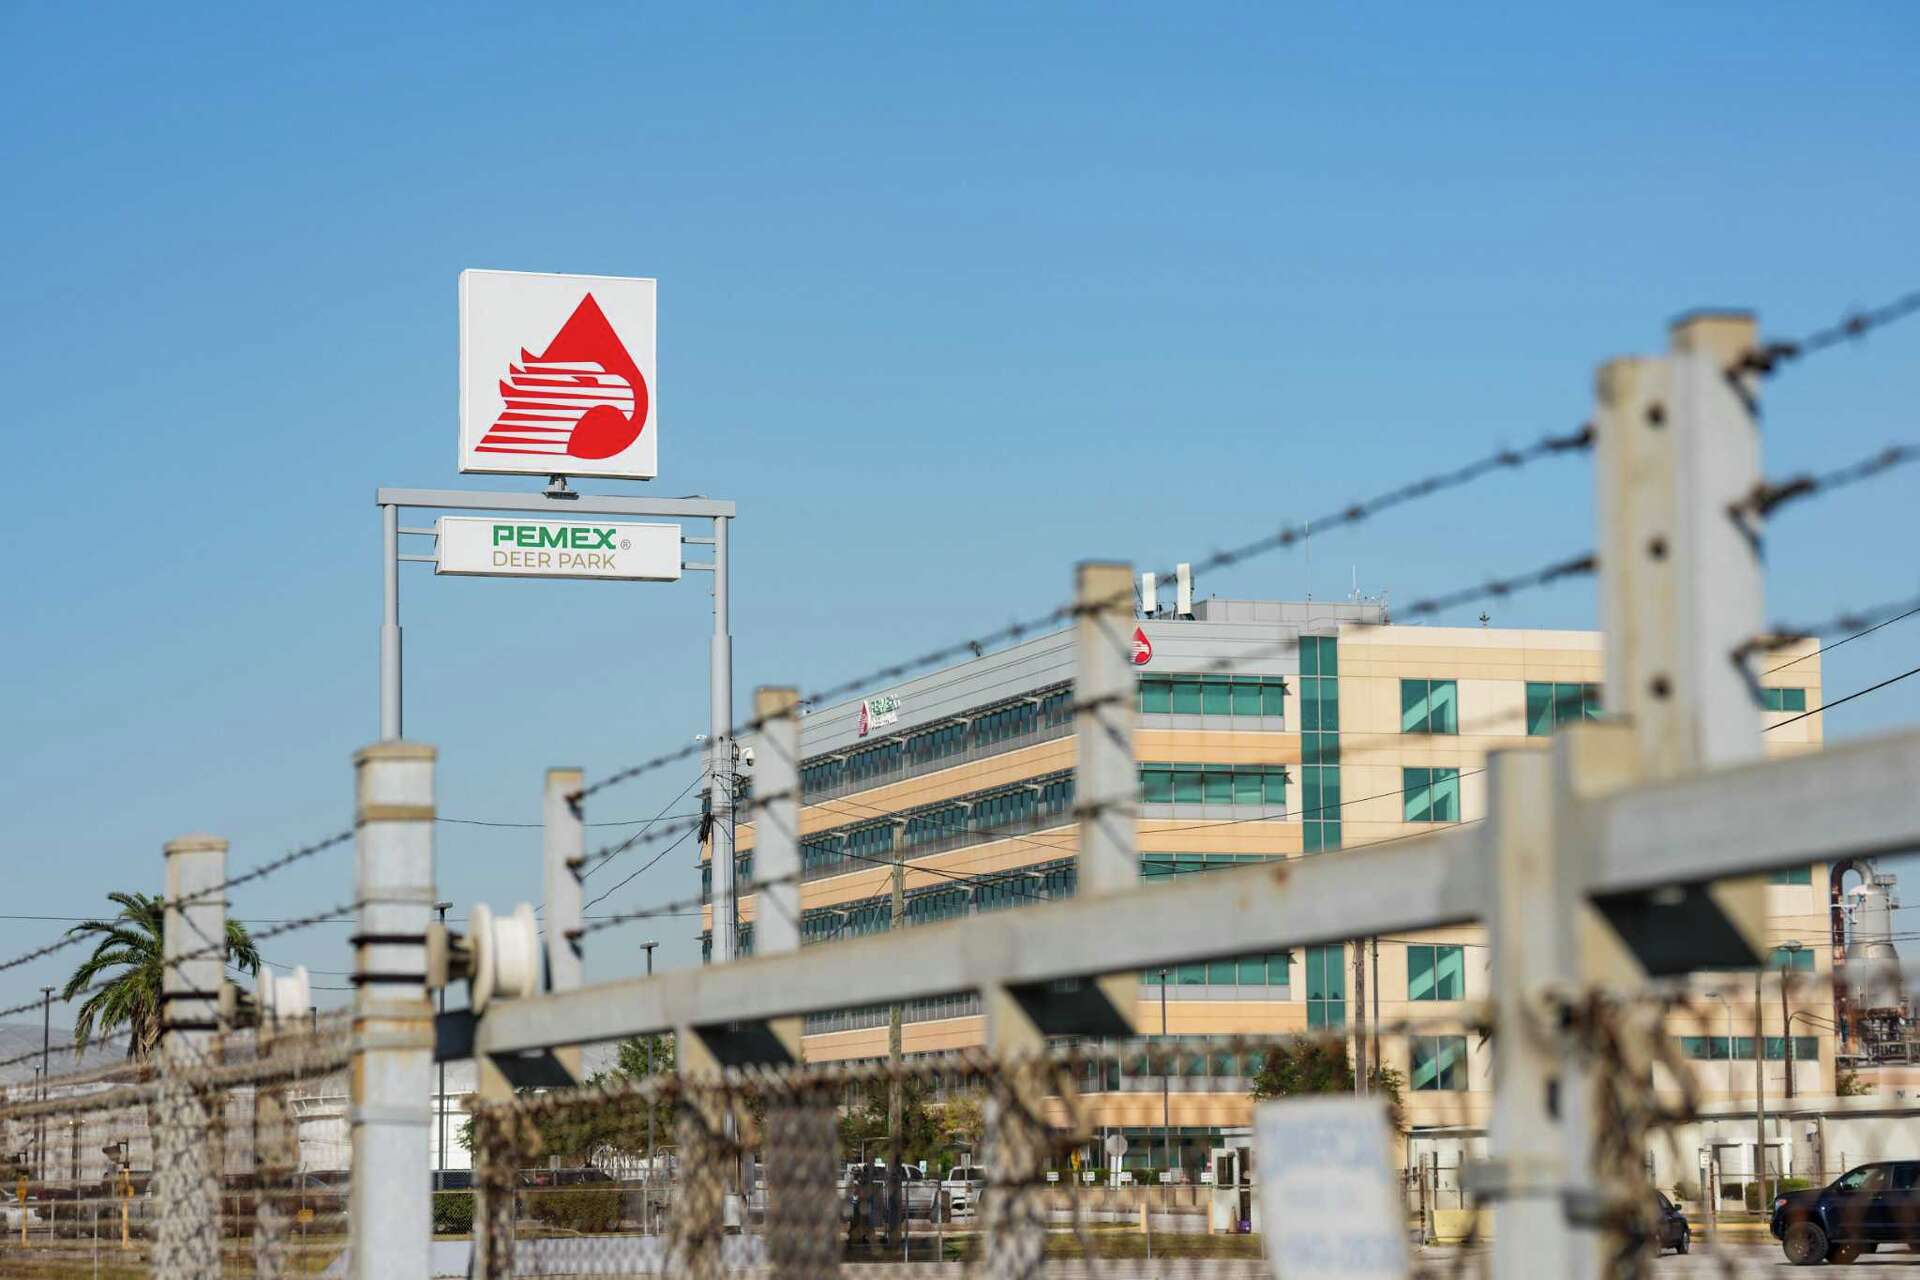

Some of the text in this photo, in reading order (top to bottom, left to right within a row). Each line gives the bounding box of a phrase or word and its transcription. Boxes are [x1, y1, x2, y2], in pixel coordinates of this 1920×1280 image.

[493, 525, 616, 550] PEMEX
[493, 551, 616, 570] DEER PARK
